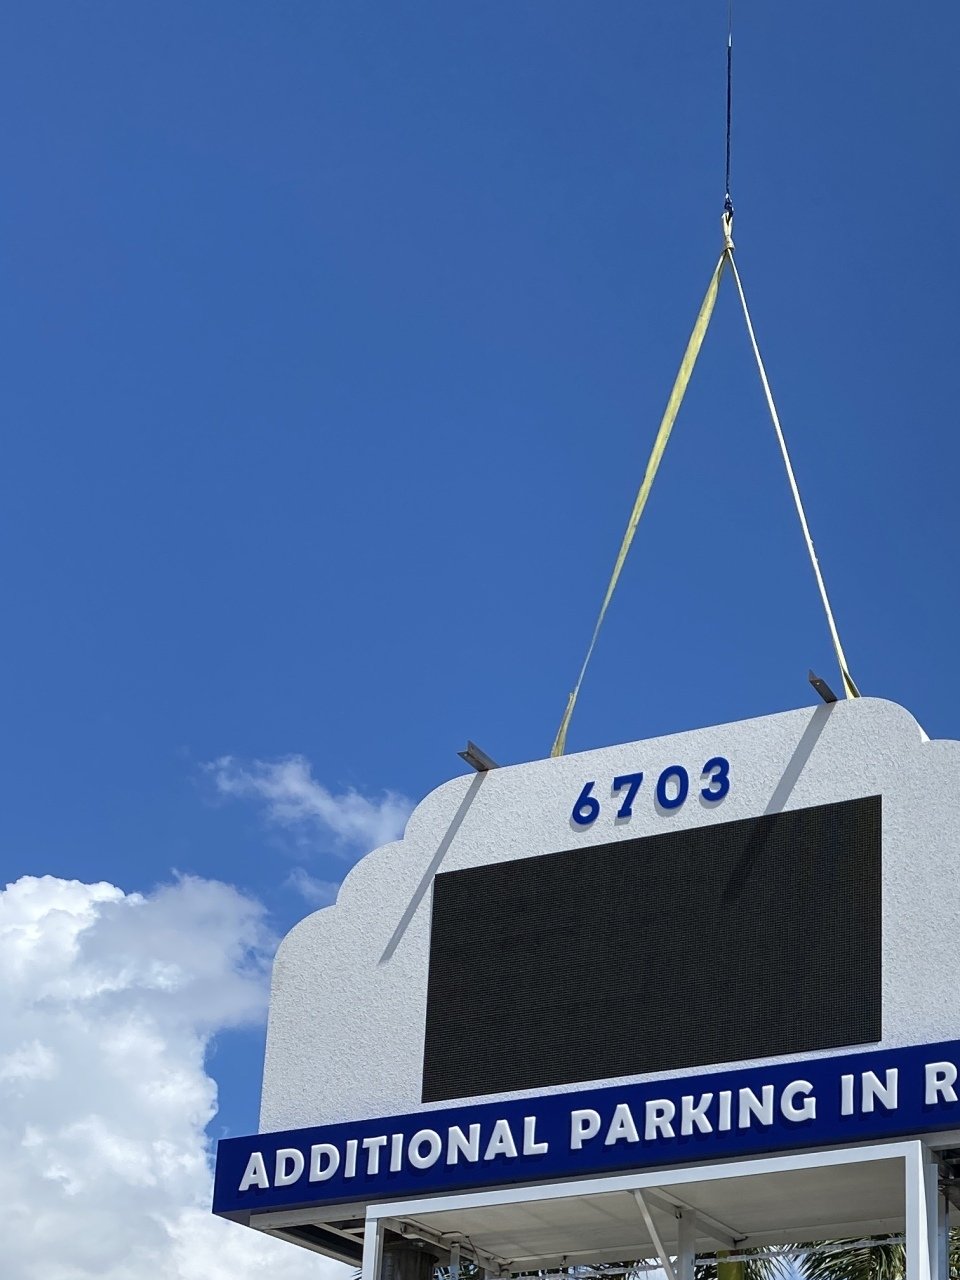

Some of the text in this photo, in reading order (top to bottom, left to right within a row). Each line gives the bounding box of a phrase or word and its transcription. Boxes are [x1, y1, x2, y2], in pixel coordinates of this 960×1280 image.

[571, 756, 731, 826] 6703
[238, 1113, 549, 1193] ADDITIONAL
[569, 1079, 818, 1151] PARKING
[840, 1067, 899, 1116] IN
